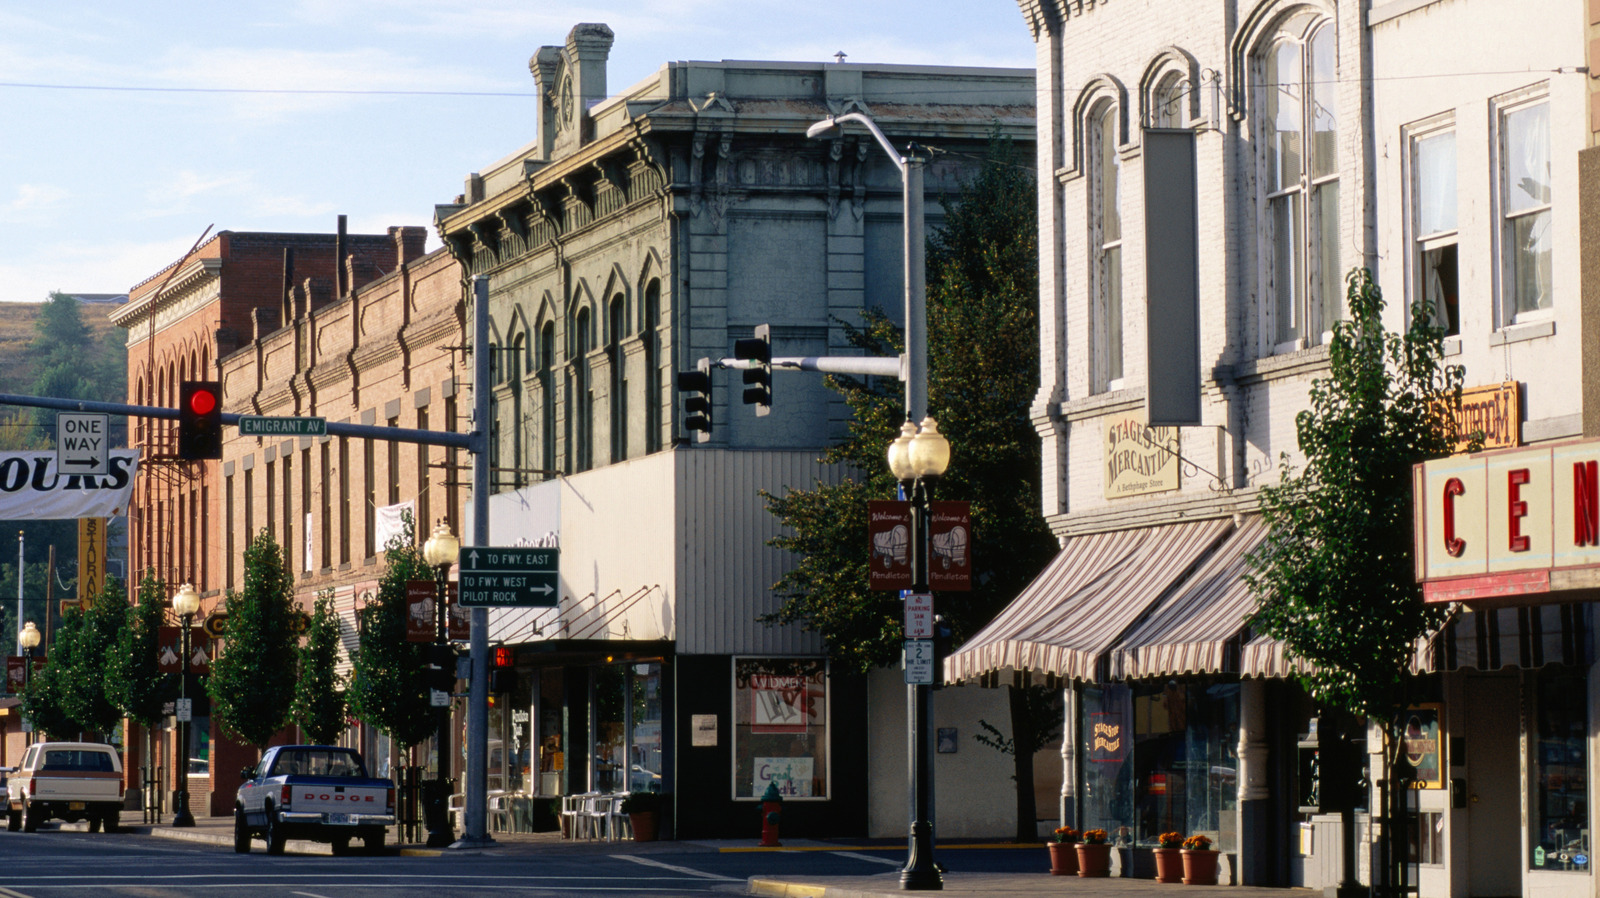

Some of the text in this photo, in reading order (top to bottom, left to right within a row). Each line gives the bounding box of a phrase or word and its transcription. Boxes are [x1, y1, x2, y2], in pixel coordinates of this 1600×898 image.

[65, 420, 101, 434] ONE
[244, 420, 320, 432] EMIGRANT AV
[64, 437, 101, 451] WAY
[1108, 443, 1173, 489] MERCANTILE
[1117, 484, 1121, 493] A
[1150, 479, 1163, 488] Store
[1443, 460, 1599, 558] CEN
[872, 511, 902, 521] Welcome
[931, 513, 961, 522] Welcome
[87, 518, 97, 607] STAURANT
[488, 554, 498, 564] TO
[526, 554, 549, 564] EAST
[872, 571, 910, 579] Pendleton
[931, 572, 968, 580] Pendleton
[463, 576, 475, 586] TO
[503, 577, 527, 587] WEST
[463, 591, 489, 601] PILOT
[493, 591, 517, 602] ROCK
[916, 648, 923, 659] 2
[760, 764, 793, 781] Great
